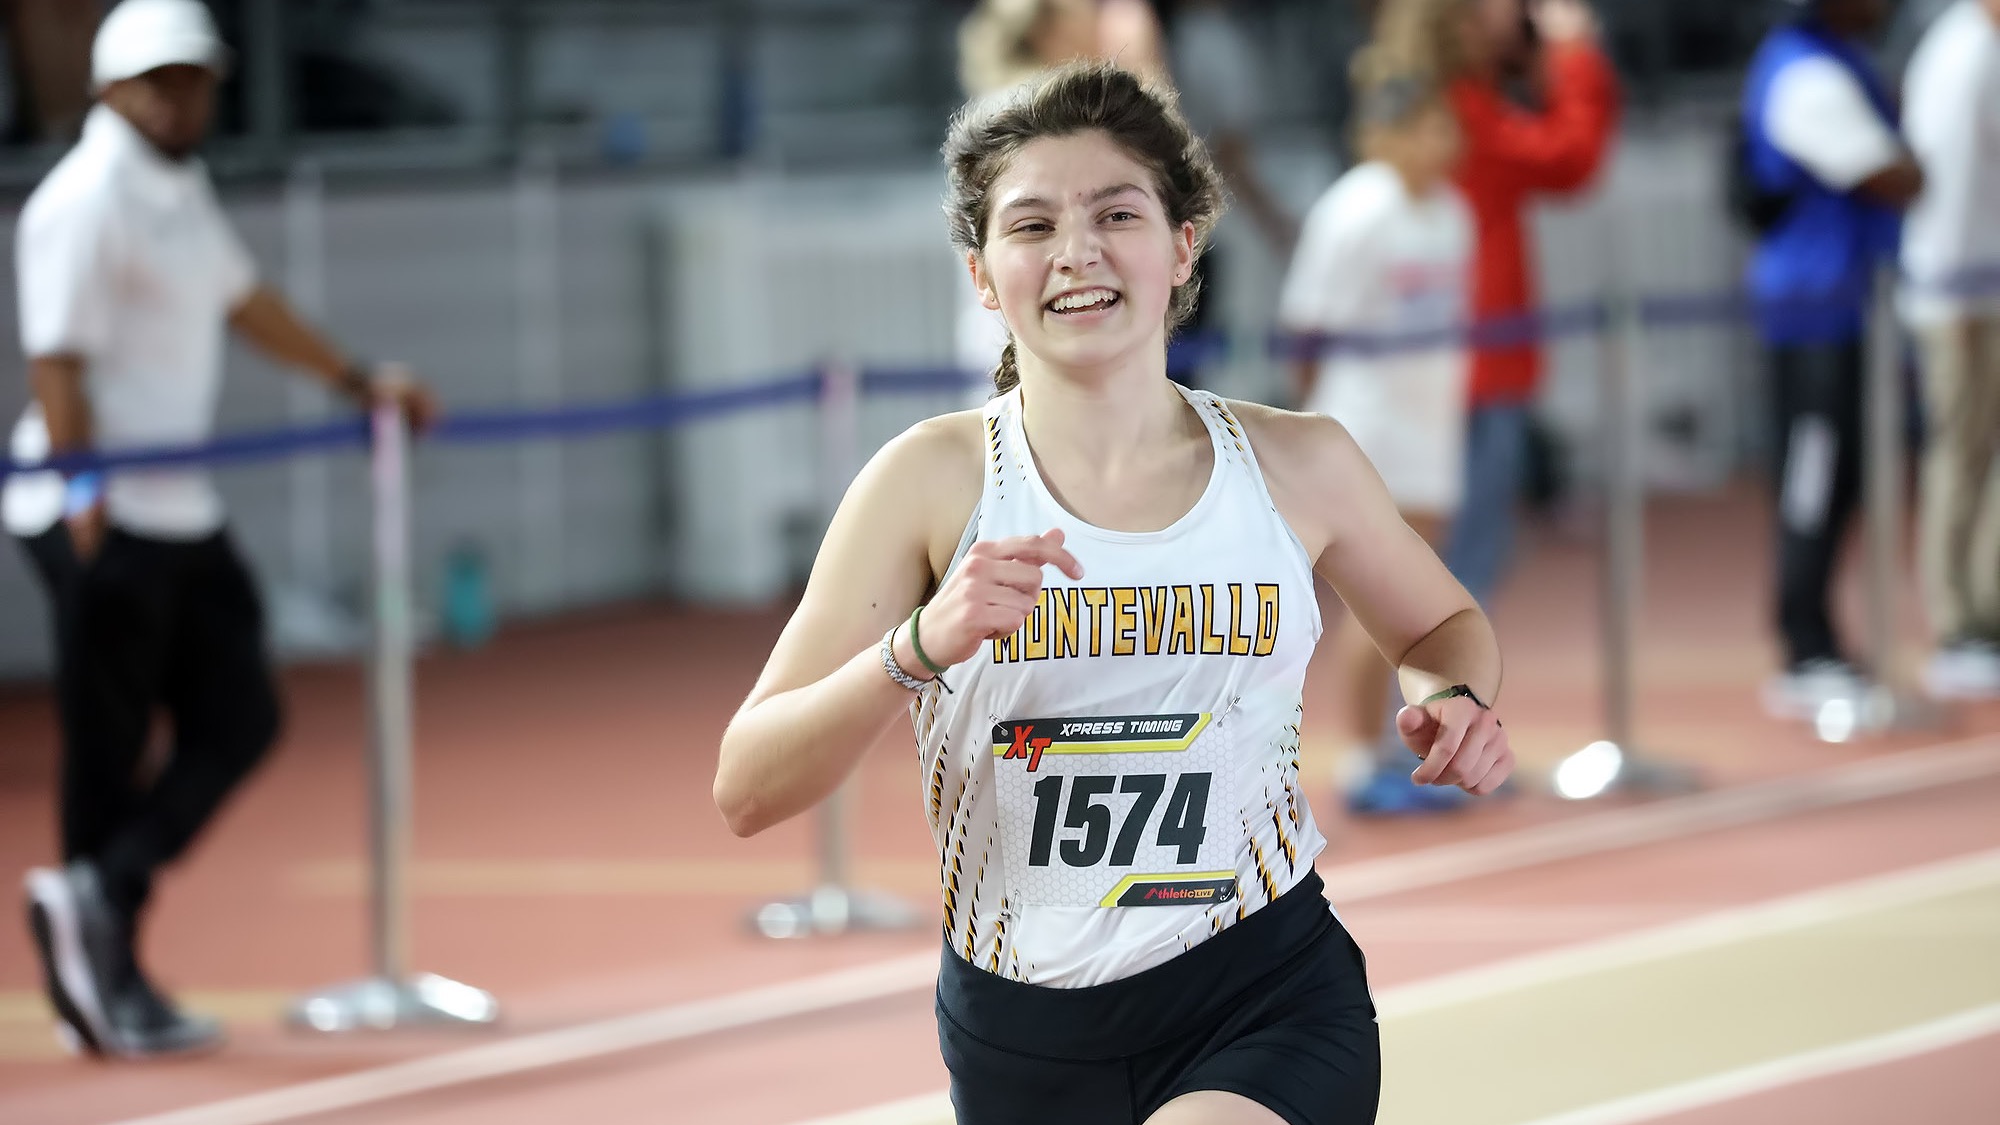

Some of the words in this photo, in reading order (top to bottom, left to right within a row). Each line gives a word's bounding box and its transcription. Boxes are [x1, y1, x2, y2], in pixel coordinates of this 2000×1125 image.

[1003, 725, 1052, 772] XT
[1060, 721, 1125, 736] XPRESS
[1130, 720, 1184, 733] TIMING
[1028, 772, 1212, 867] 1574
